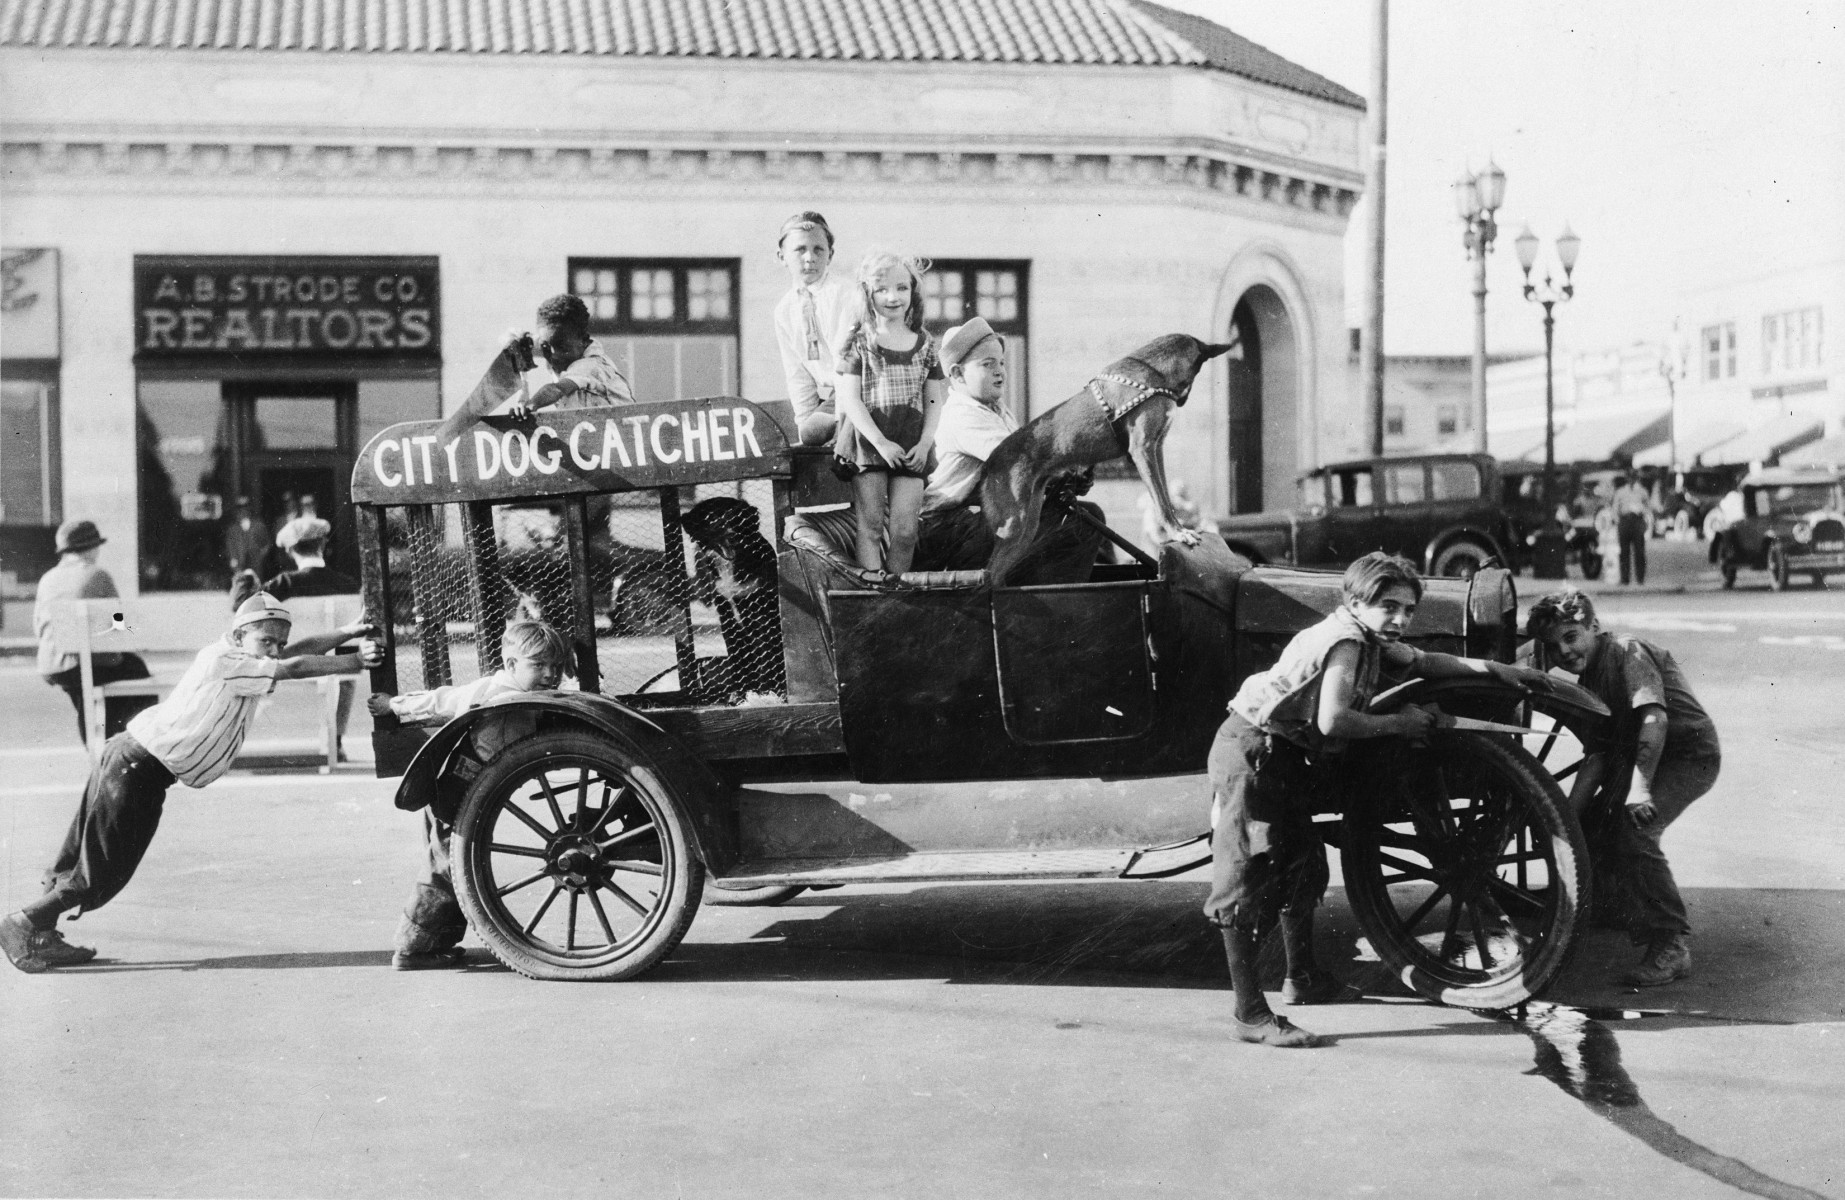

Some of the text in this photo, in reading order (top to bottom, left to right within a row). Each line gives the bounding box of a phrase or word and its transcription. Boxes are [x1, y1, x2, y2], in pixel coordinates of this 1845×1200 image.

[227, 275, 361, 301] STRODE
[373, 275, 425, 301] CO.
[143, 308, 432, 348] REALTORS
[374, 407, 763, 487] CITY DOG CATCHER
